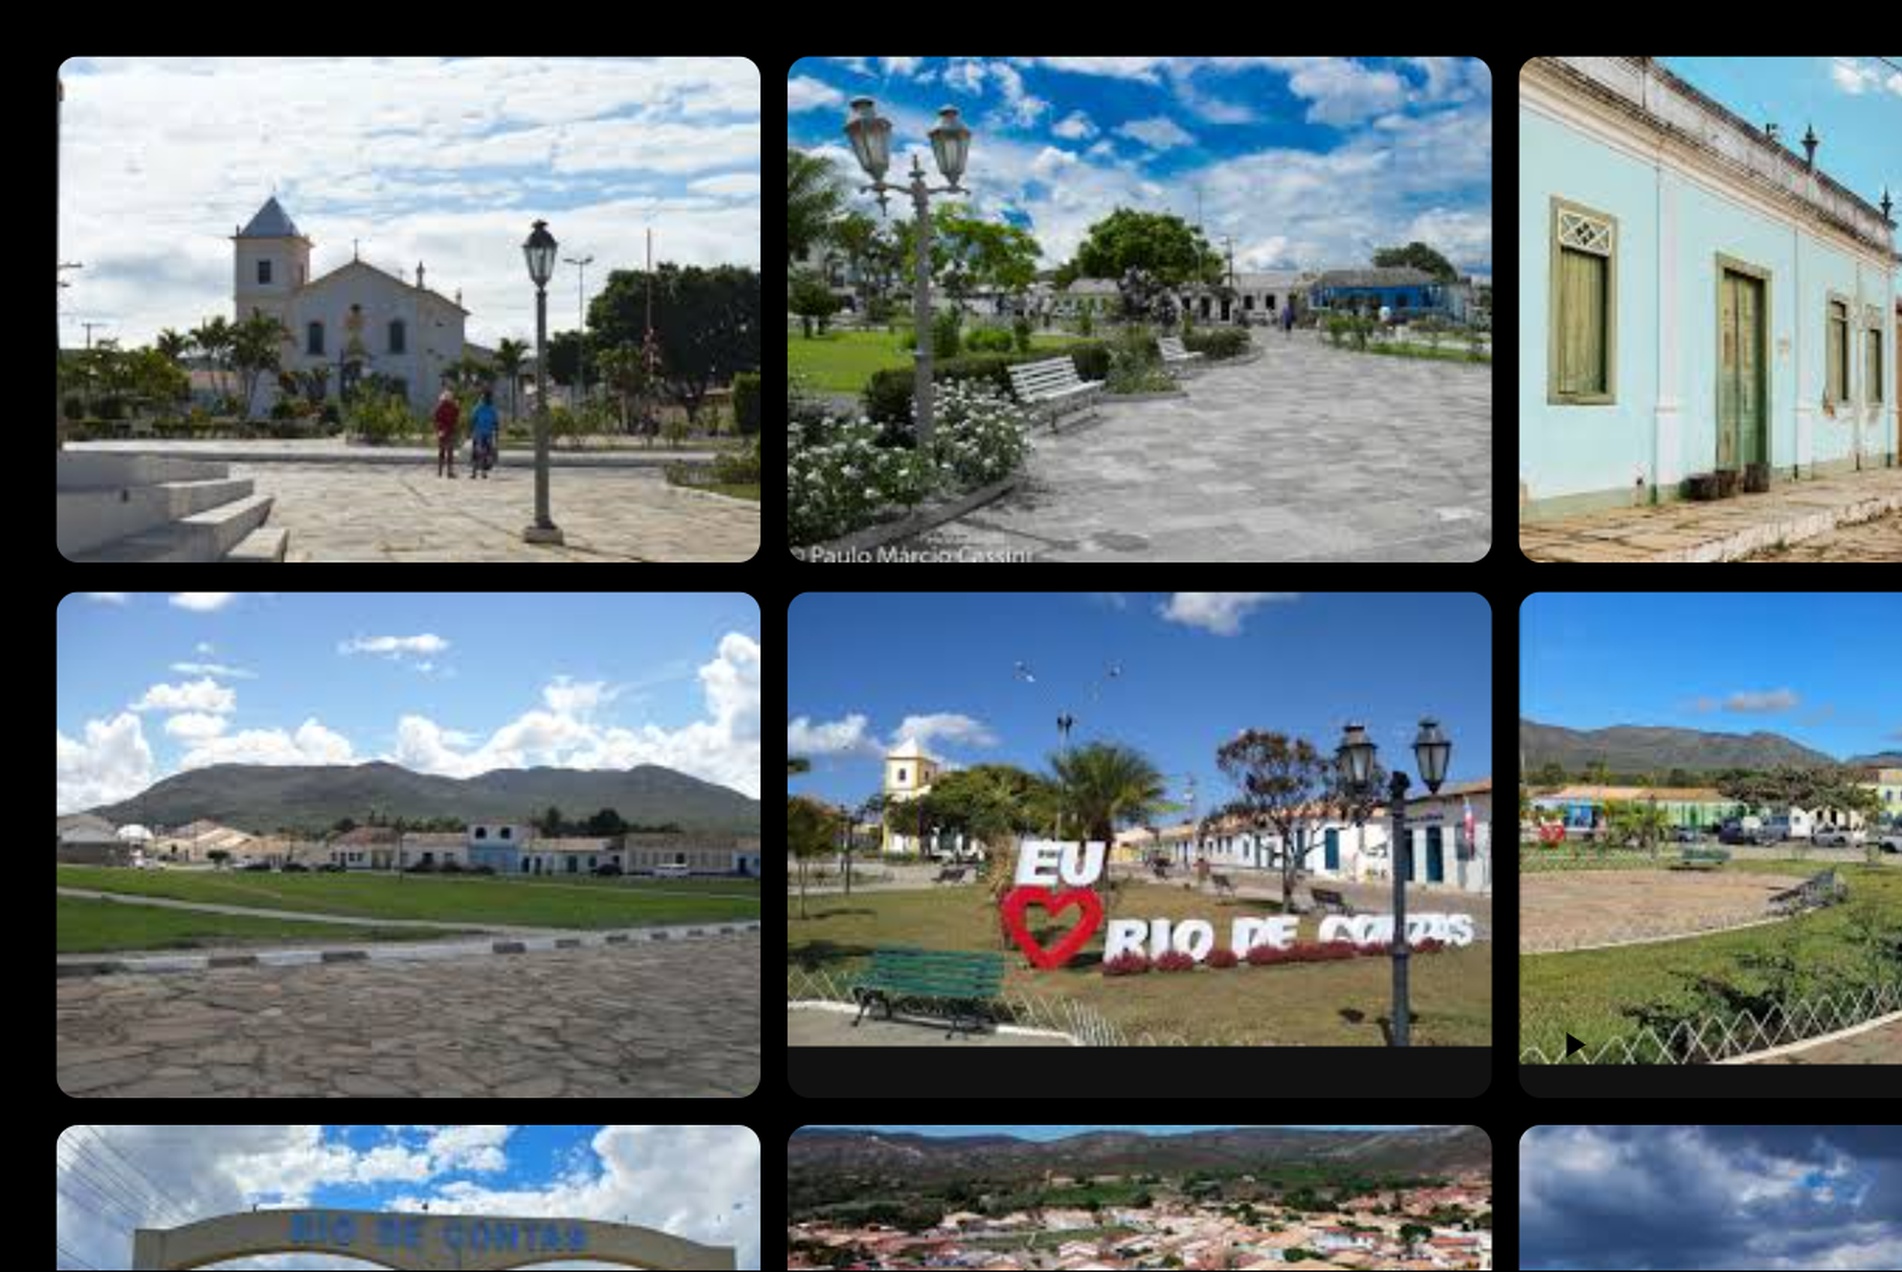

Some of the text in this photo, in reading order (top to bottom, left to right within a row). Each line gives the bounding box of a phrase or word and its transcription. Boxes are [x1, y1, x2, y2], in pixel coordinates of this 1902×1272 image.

[1014, 839, 1106, 888] EU
[1102, 917, 1214, 965] RIO
[1231, 913, 1301, 960] DE
[290, 1213, 588, 1251] RIO DE CONTAS
